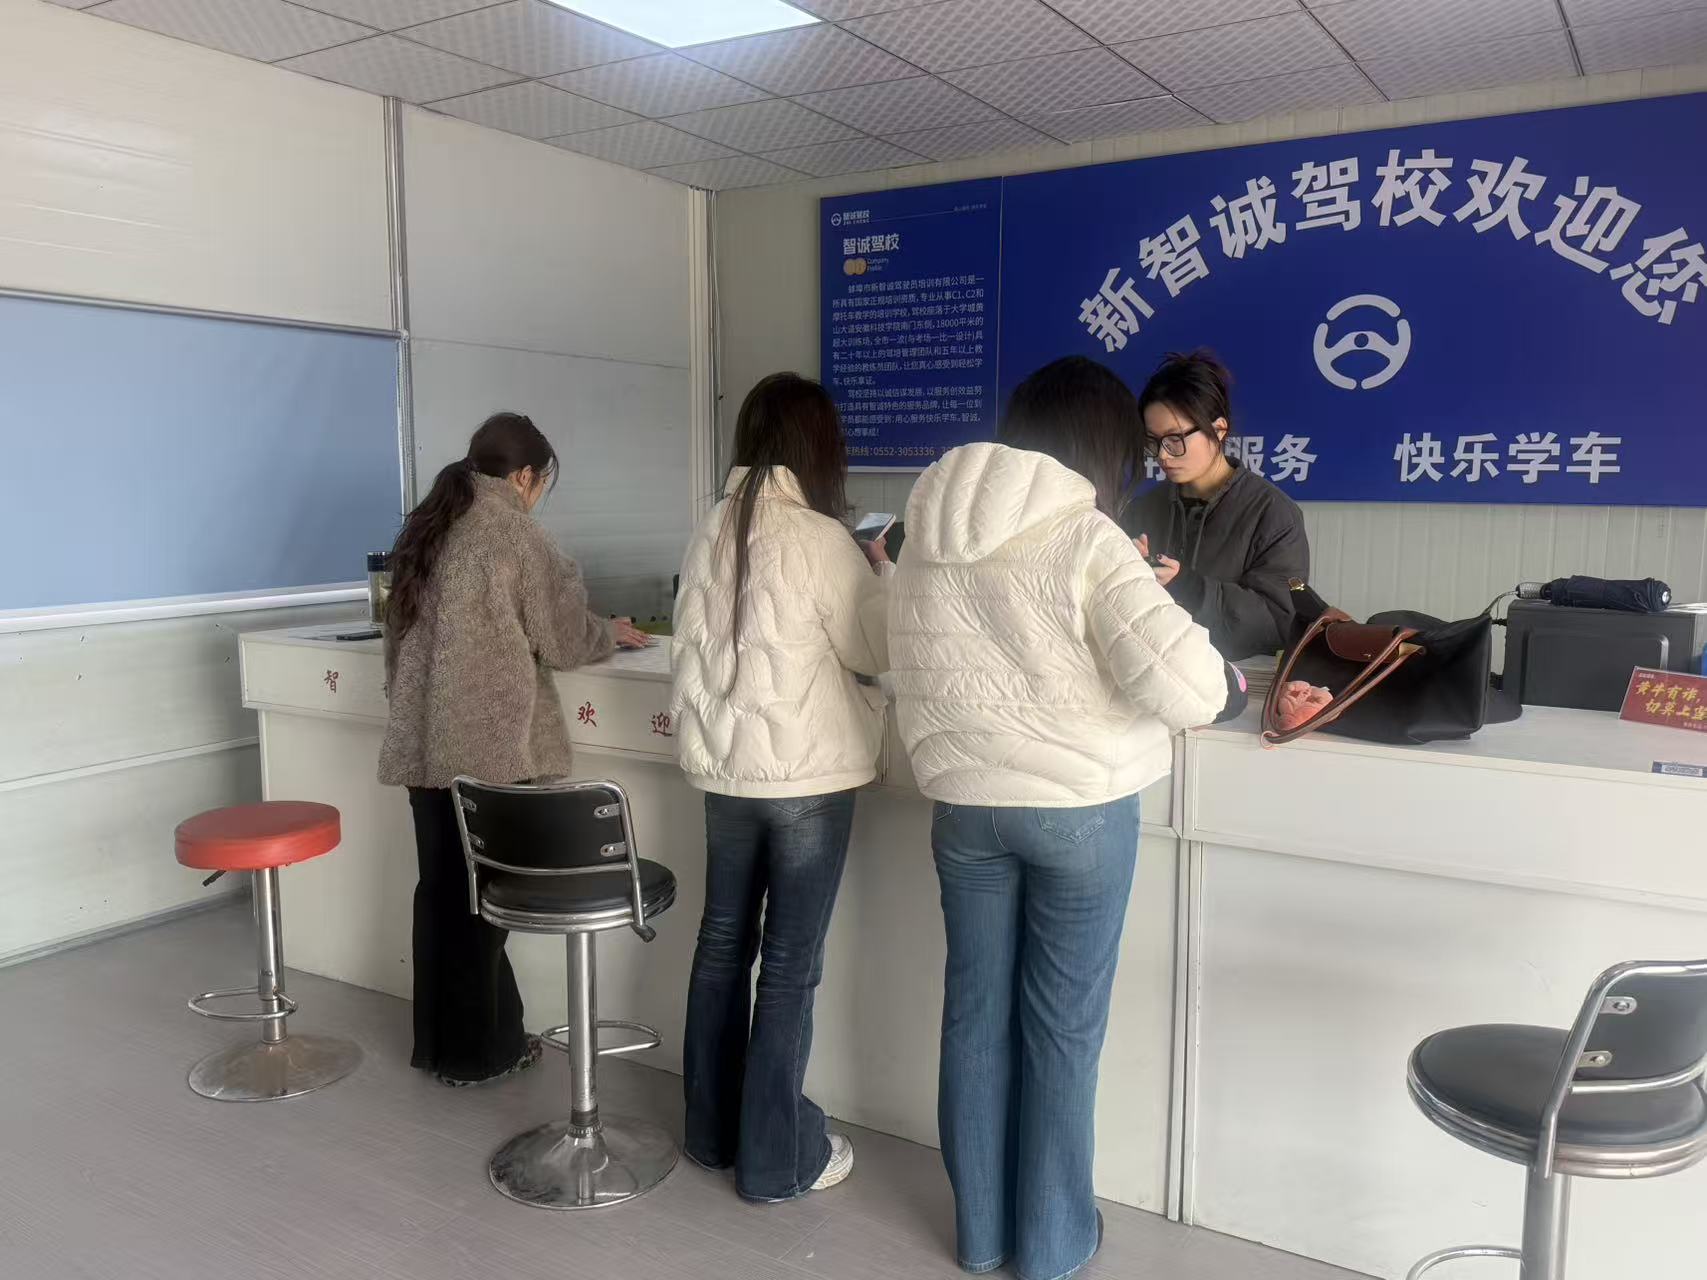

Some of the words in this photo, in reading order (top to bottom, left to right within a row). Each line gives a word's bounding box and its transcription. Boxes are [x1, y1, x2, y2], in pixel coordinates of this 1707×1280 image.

[843, 233, 900, 255] 智诚驾校
[1079, 149, 1707, 352] 新智诚驾校欢迎您
[1394, 431, 1622, 484] 快乐学车
[324, 669, 339, 694] 智
[577, 701, 597, 728] 欢
[651, 712, 673, 737] 迎
